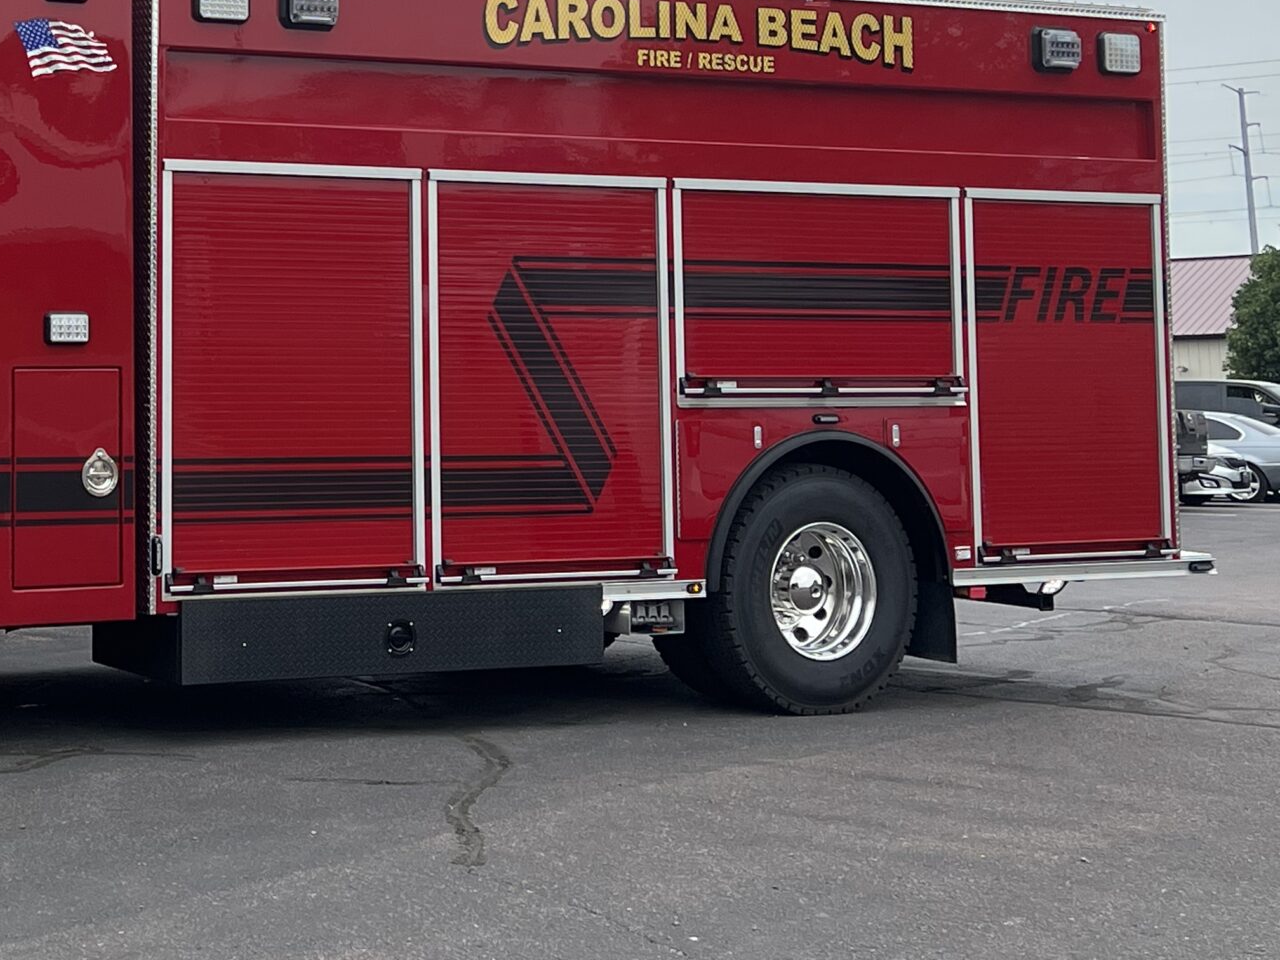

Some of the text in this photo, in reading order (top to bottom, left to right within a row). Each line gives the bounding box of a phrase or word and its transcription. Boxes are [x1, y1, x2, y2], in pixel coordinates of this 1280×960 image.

[636, 49, 681, 69] FIRE
[698, 52, 775, 73] RESCUE
[757, 7, 914, 70] BEACH
[1004, 266, 1126, 322] FIRE
